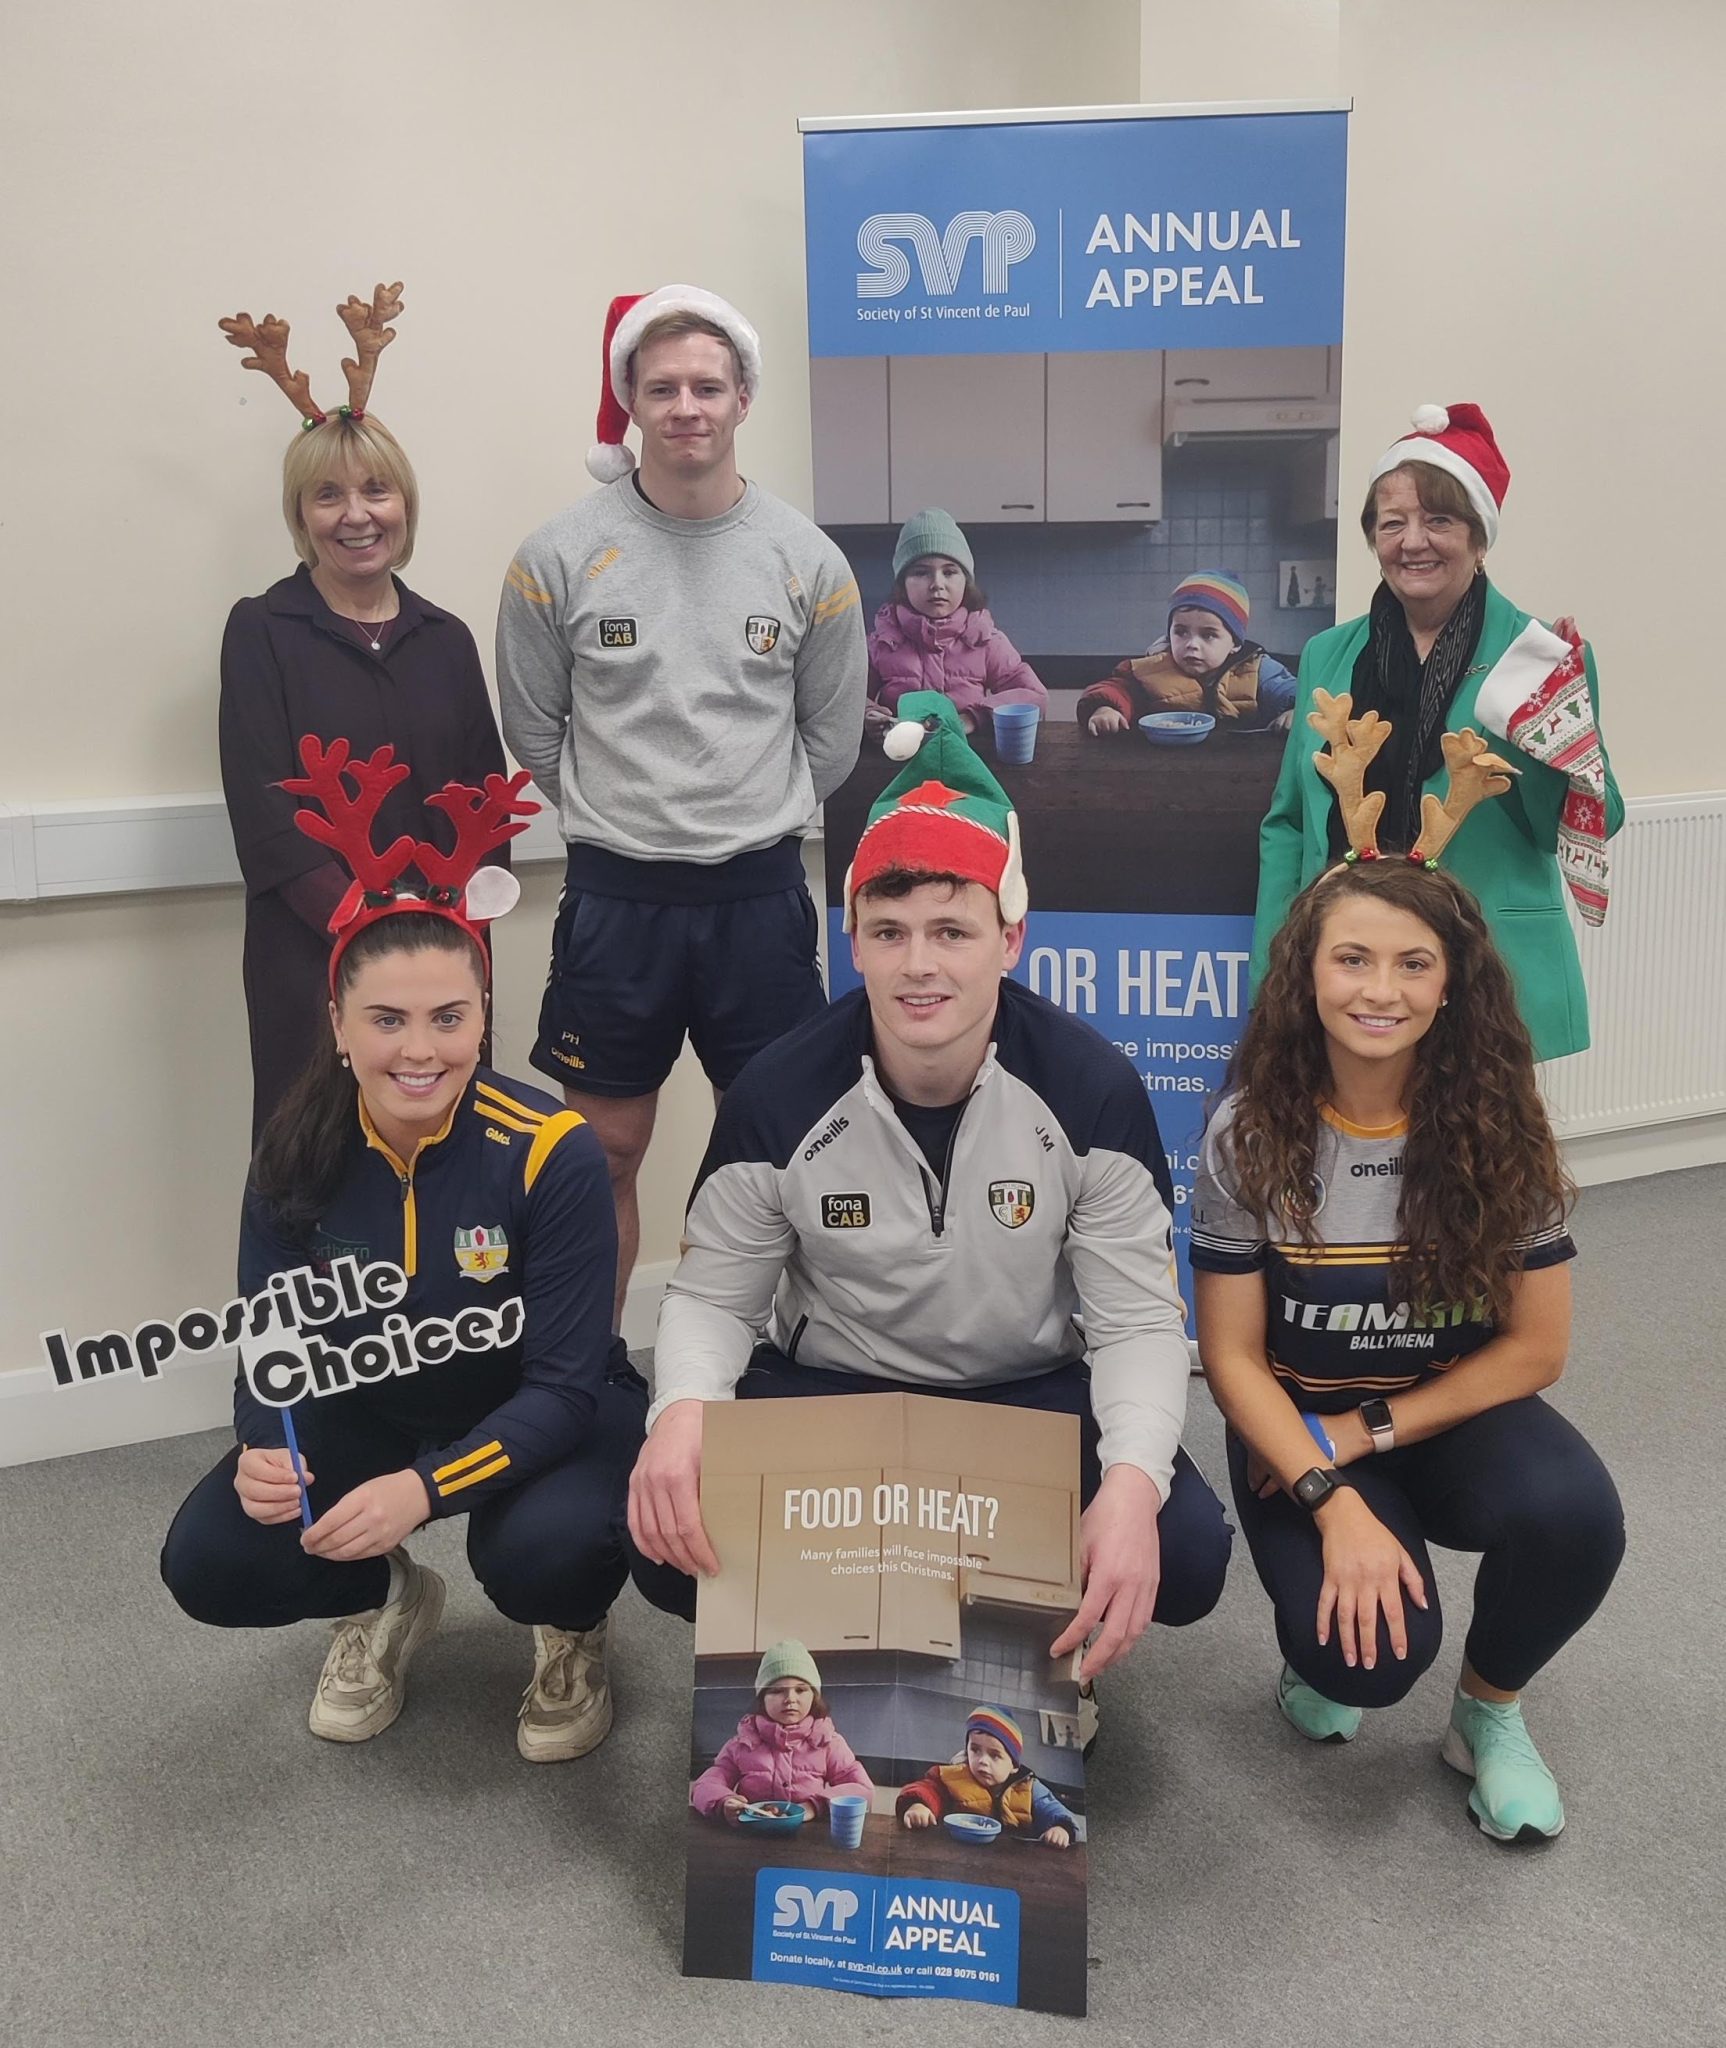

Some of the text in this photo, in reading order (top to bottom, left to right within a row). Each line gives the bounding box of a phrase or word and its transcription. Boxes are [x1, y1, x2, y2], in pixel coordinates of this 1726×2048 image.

[1085, 209, 1301, 254] ANNUAL
[1085, 265, 1264, 309] APPEAL
[856, 303, 1030, 323] Society of St Vincent de Paul
[604, 620, 631, 633] fona
[604, 632, 633, 645] CAB
[1028, 947, 1097, 1014] OR
[561, 1030, 580, 1045] PH
[1146, 1037, 1239, 1063] imposs
[1140, 1071, 1211, 1093] tmas.
[827, 1195, 862, 1212] fona
[826, 1210, 866, 1227] CAB
[46, 1256, 403, 1385] Impossible
[252, 1302, 521, 1405] Choices
[1349, 1333, 1435, 1350] BALLYMENA
[784, 1483, 999, 1539] FOOD OR HEAT?
[800, 1544, 982, 1570] Many families will face impossible
[831, 1561, 955, 1581] choices this Christmas.
[885, 1895, 1001, 1929] ANNUAL
[842, 1936, 856, 1945] Paul
[884, 1926, 987, 1957] APPEAL
[770, 1952, 1000, 1984] Donate locally, at svp-ni.co.uk or call 028 9075 0161
